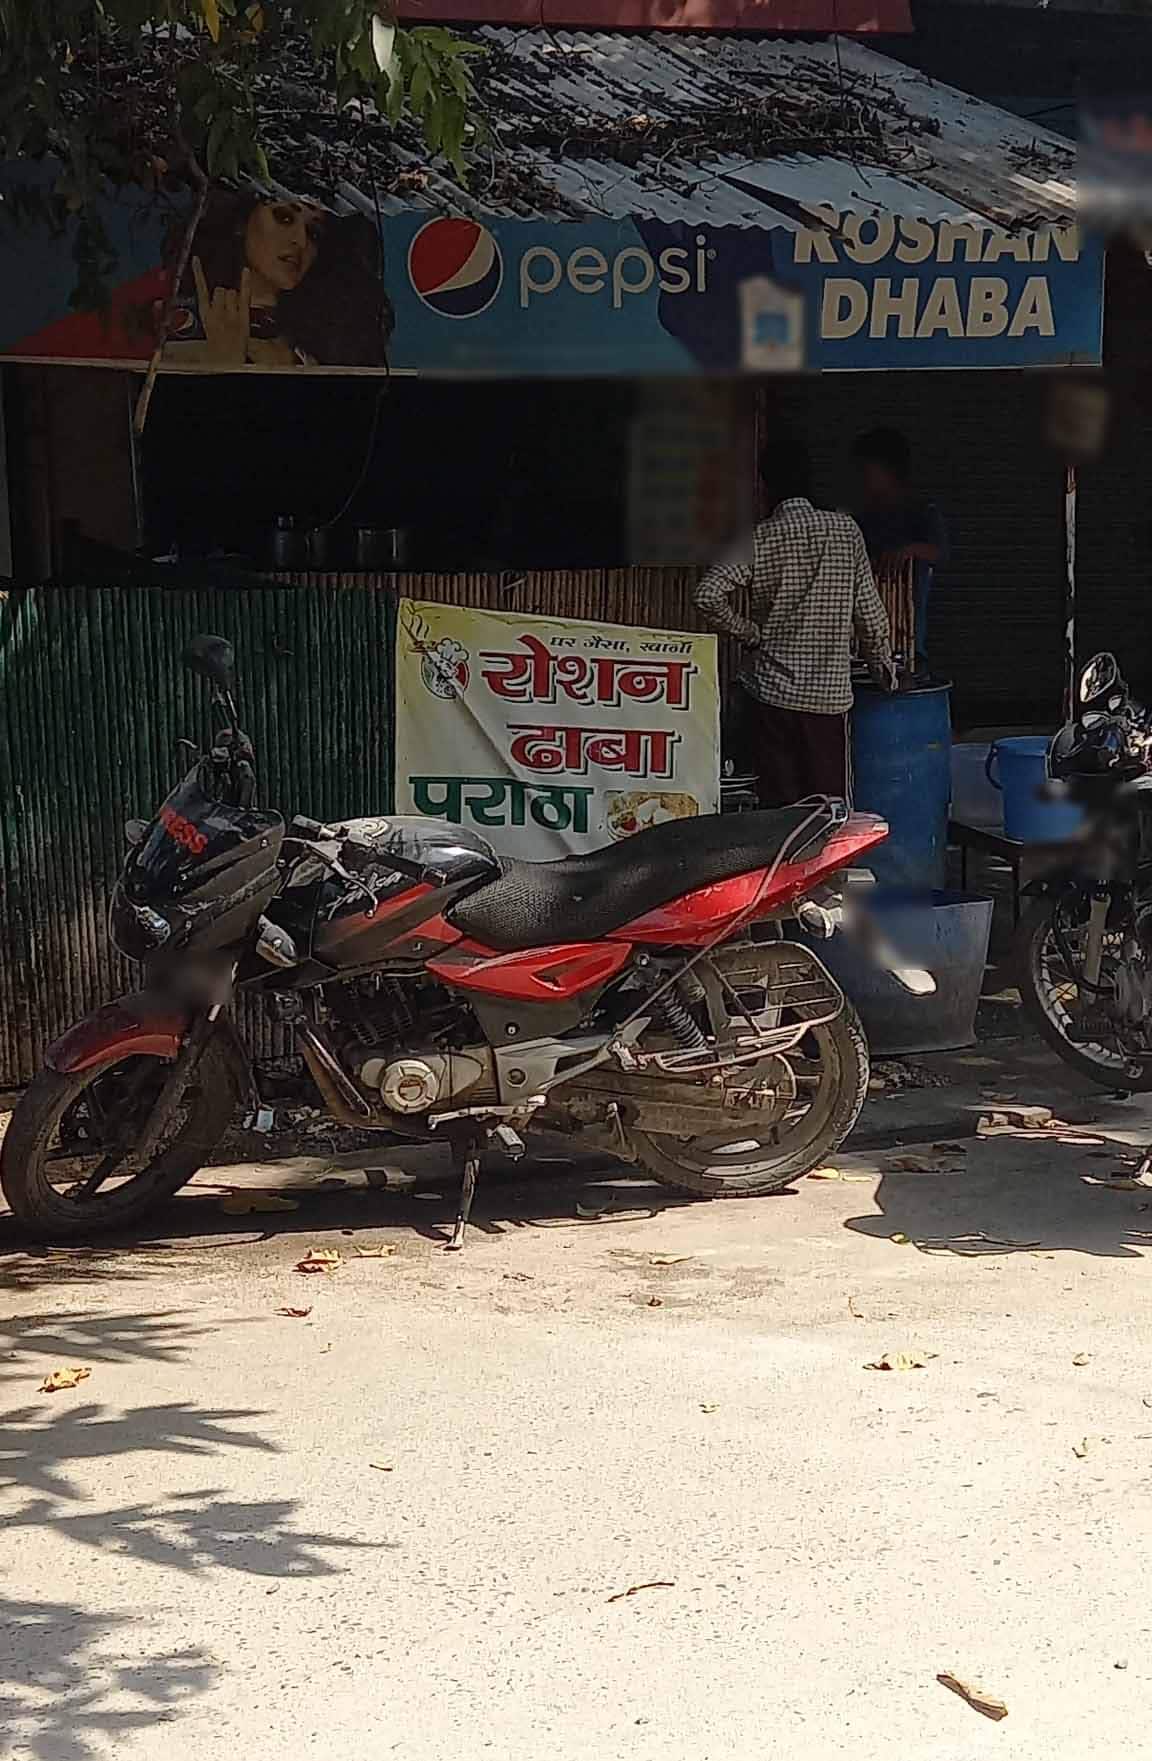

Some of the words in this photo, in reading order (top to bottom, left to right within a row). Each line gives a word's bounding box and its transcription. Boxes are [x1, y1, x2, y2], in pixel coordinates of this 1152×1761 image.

[519, 233, 708, 309] pepsi
[820, 276, 1056, 339] DHABA
[479, 633, 695, 709] रोशन
[506, 723, 679, 777] ढाबा
[408, 776, 594, 834] पराठा
